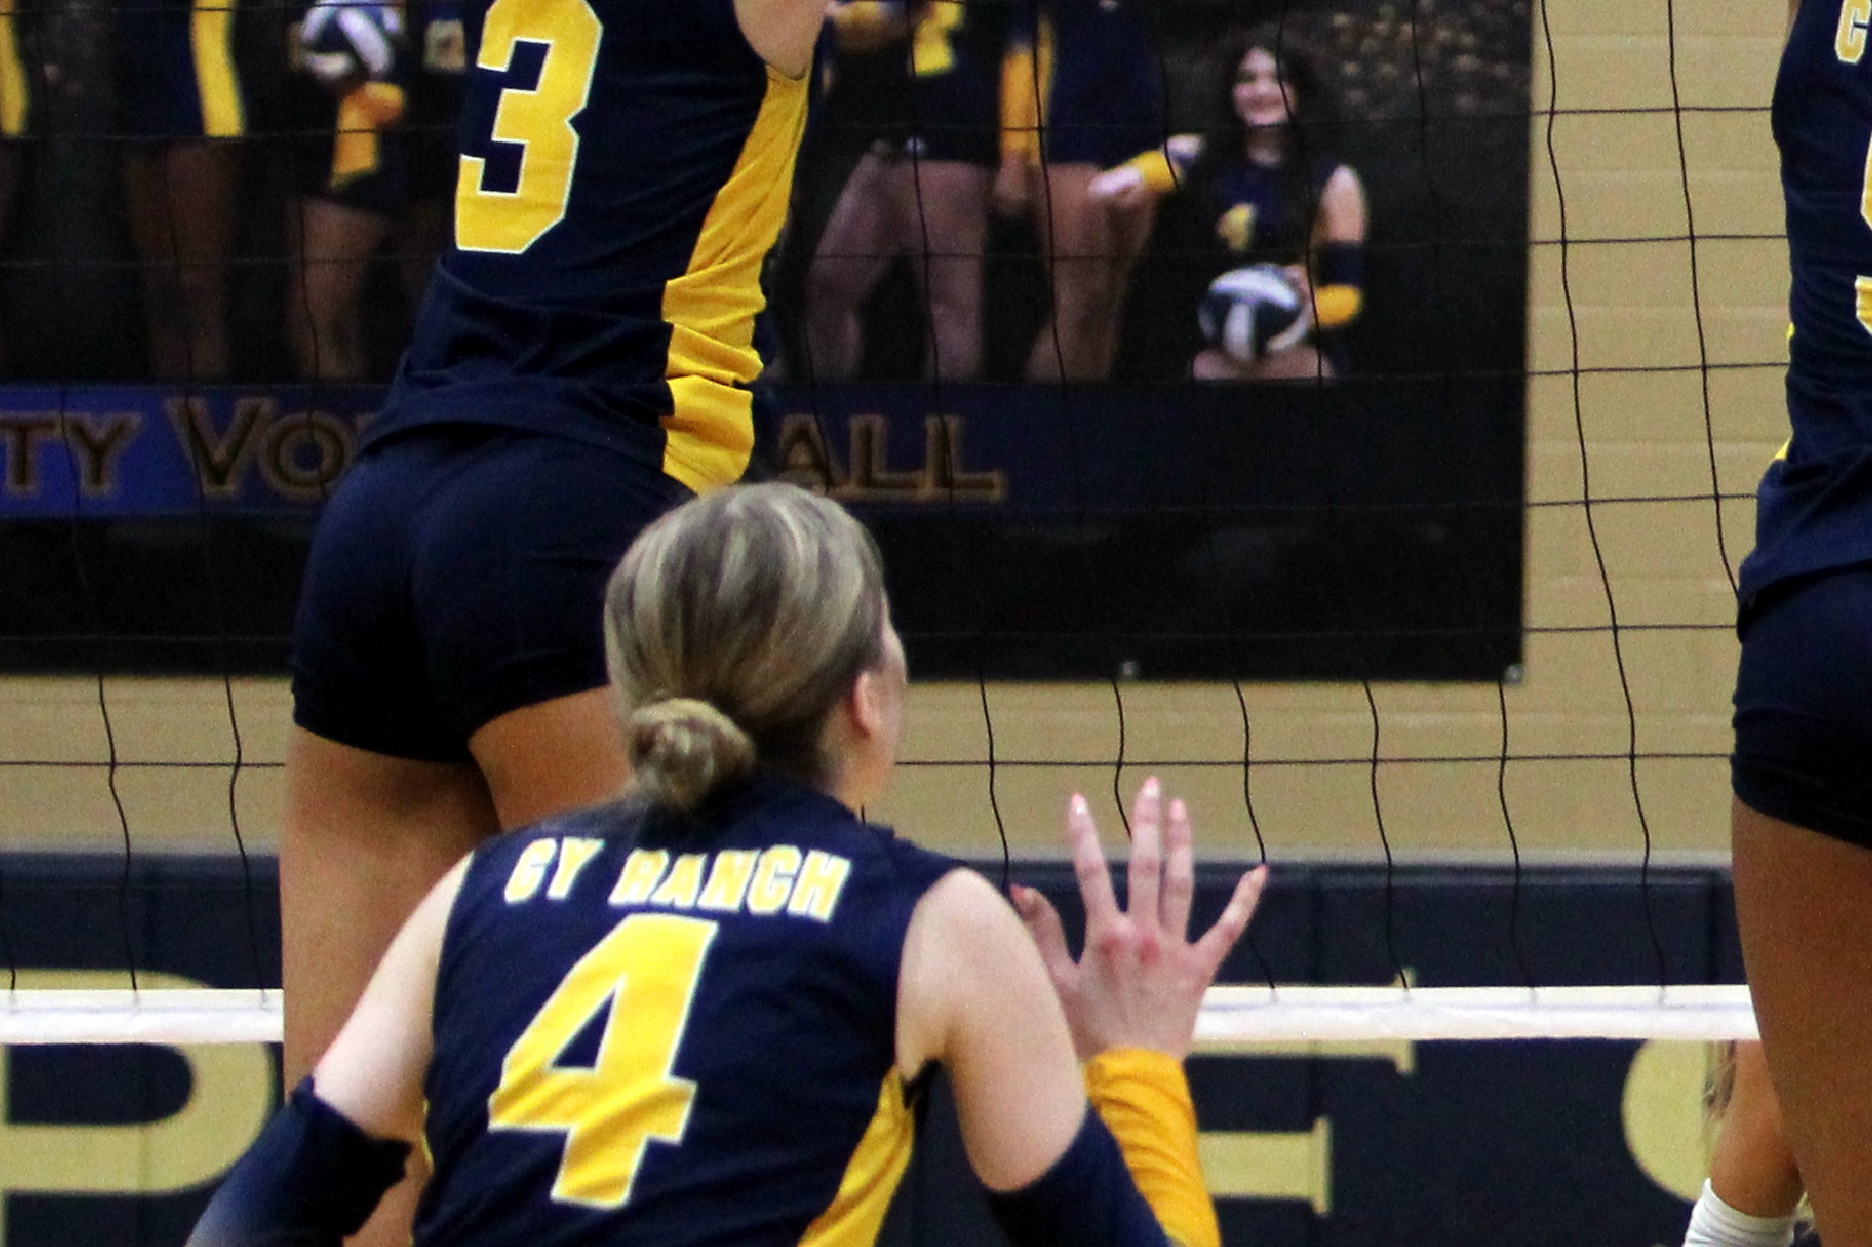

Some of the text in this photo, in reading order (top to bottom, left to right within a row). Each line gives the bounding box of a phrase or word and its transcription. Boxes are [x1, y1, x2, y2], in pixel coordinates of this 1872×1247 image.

[503, 836, 852, 924] CY RANCH
[487, 912, 719, 1211] 4
